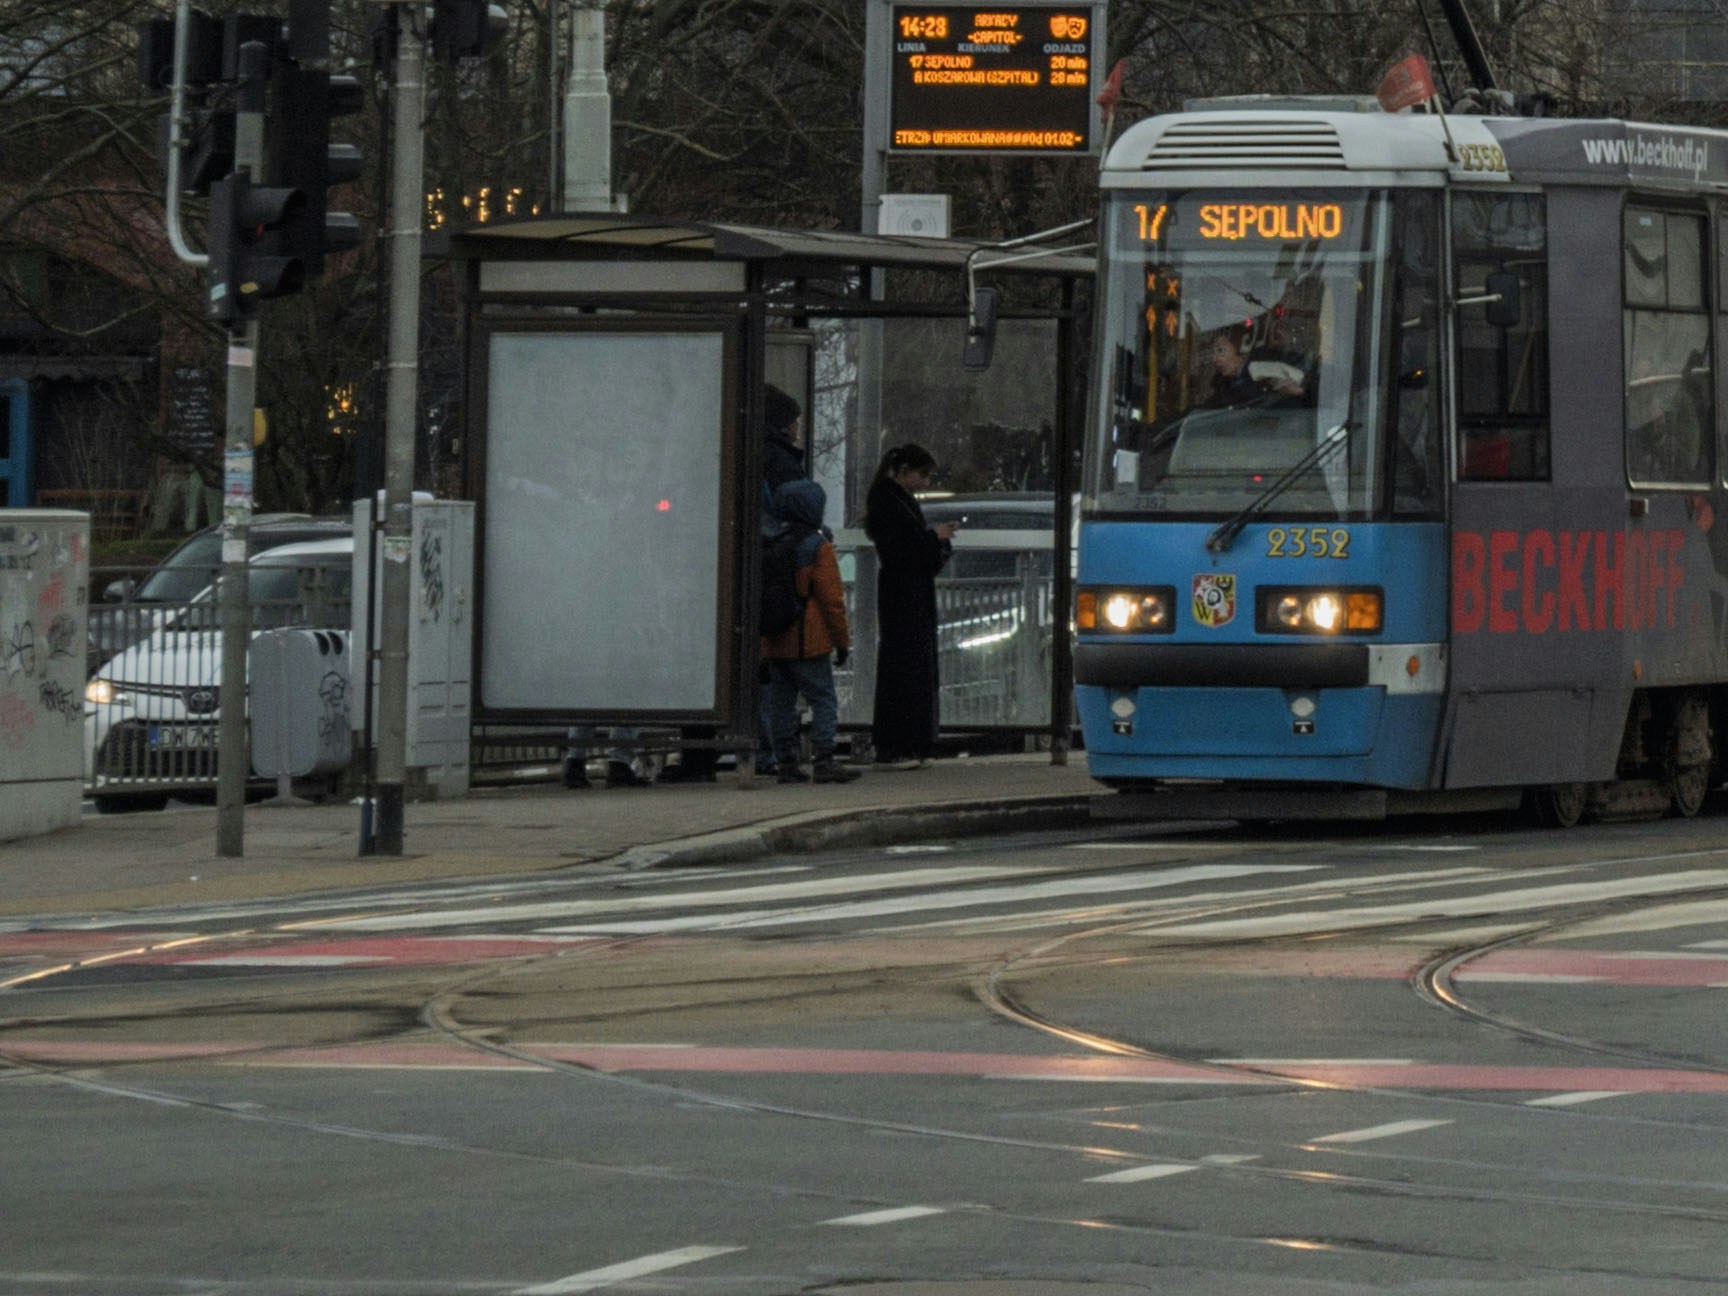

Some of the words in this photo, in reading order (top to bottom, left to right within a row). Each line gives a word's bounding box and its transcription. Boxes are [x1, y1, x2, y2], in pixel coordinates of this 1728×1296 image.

[898, 43, 926, 52] LINIA
[958, 43, 1010, 53] KIERUNEK
[1043, 43, 1086, 53] ODJAZD
[1067, 57, 1087, 69] min
[1067, 72, 1087, 85] min
[1582, 134, 1708, 181] www.beckhoff.pl
[1267, 528, 1349, 558] 2352
[1453, 528, 1685, 634] BECKHOFF
